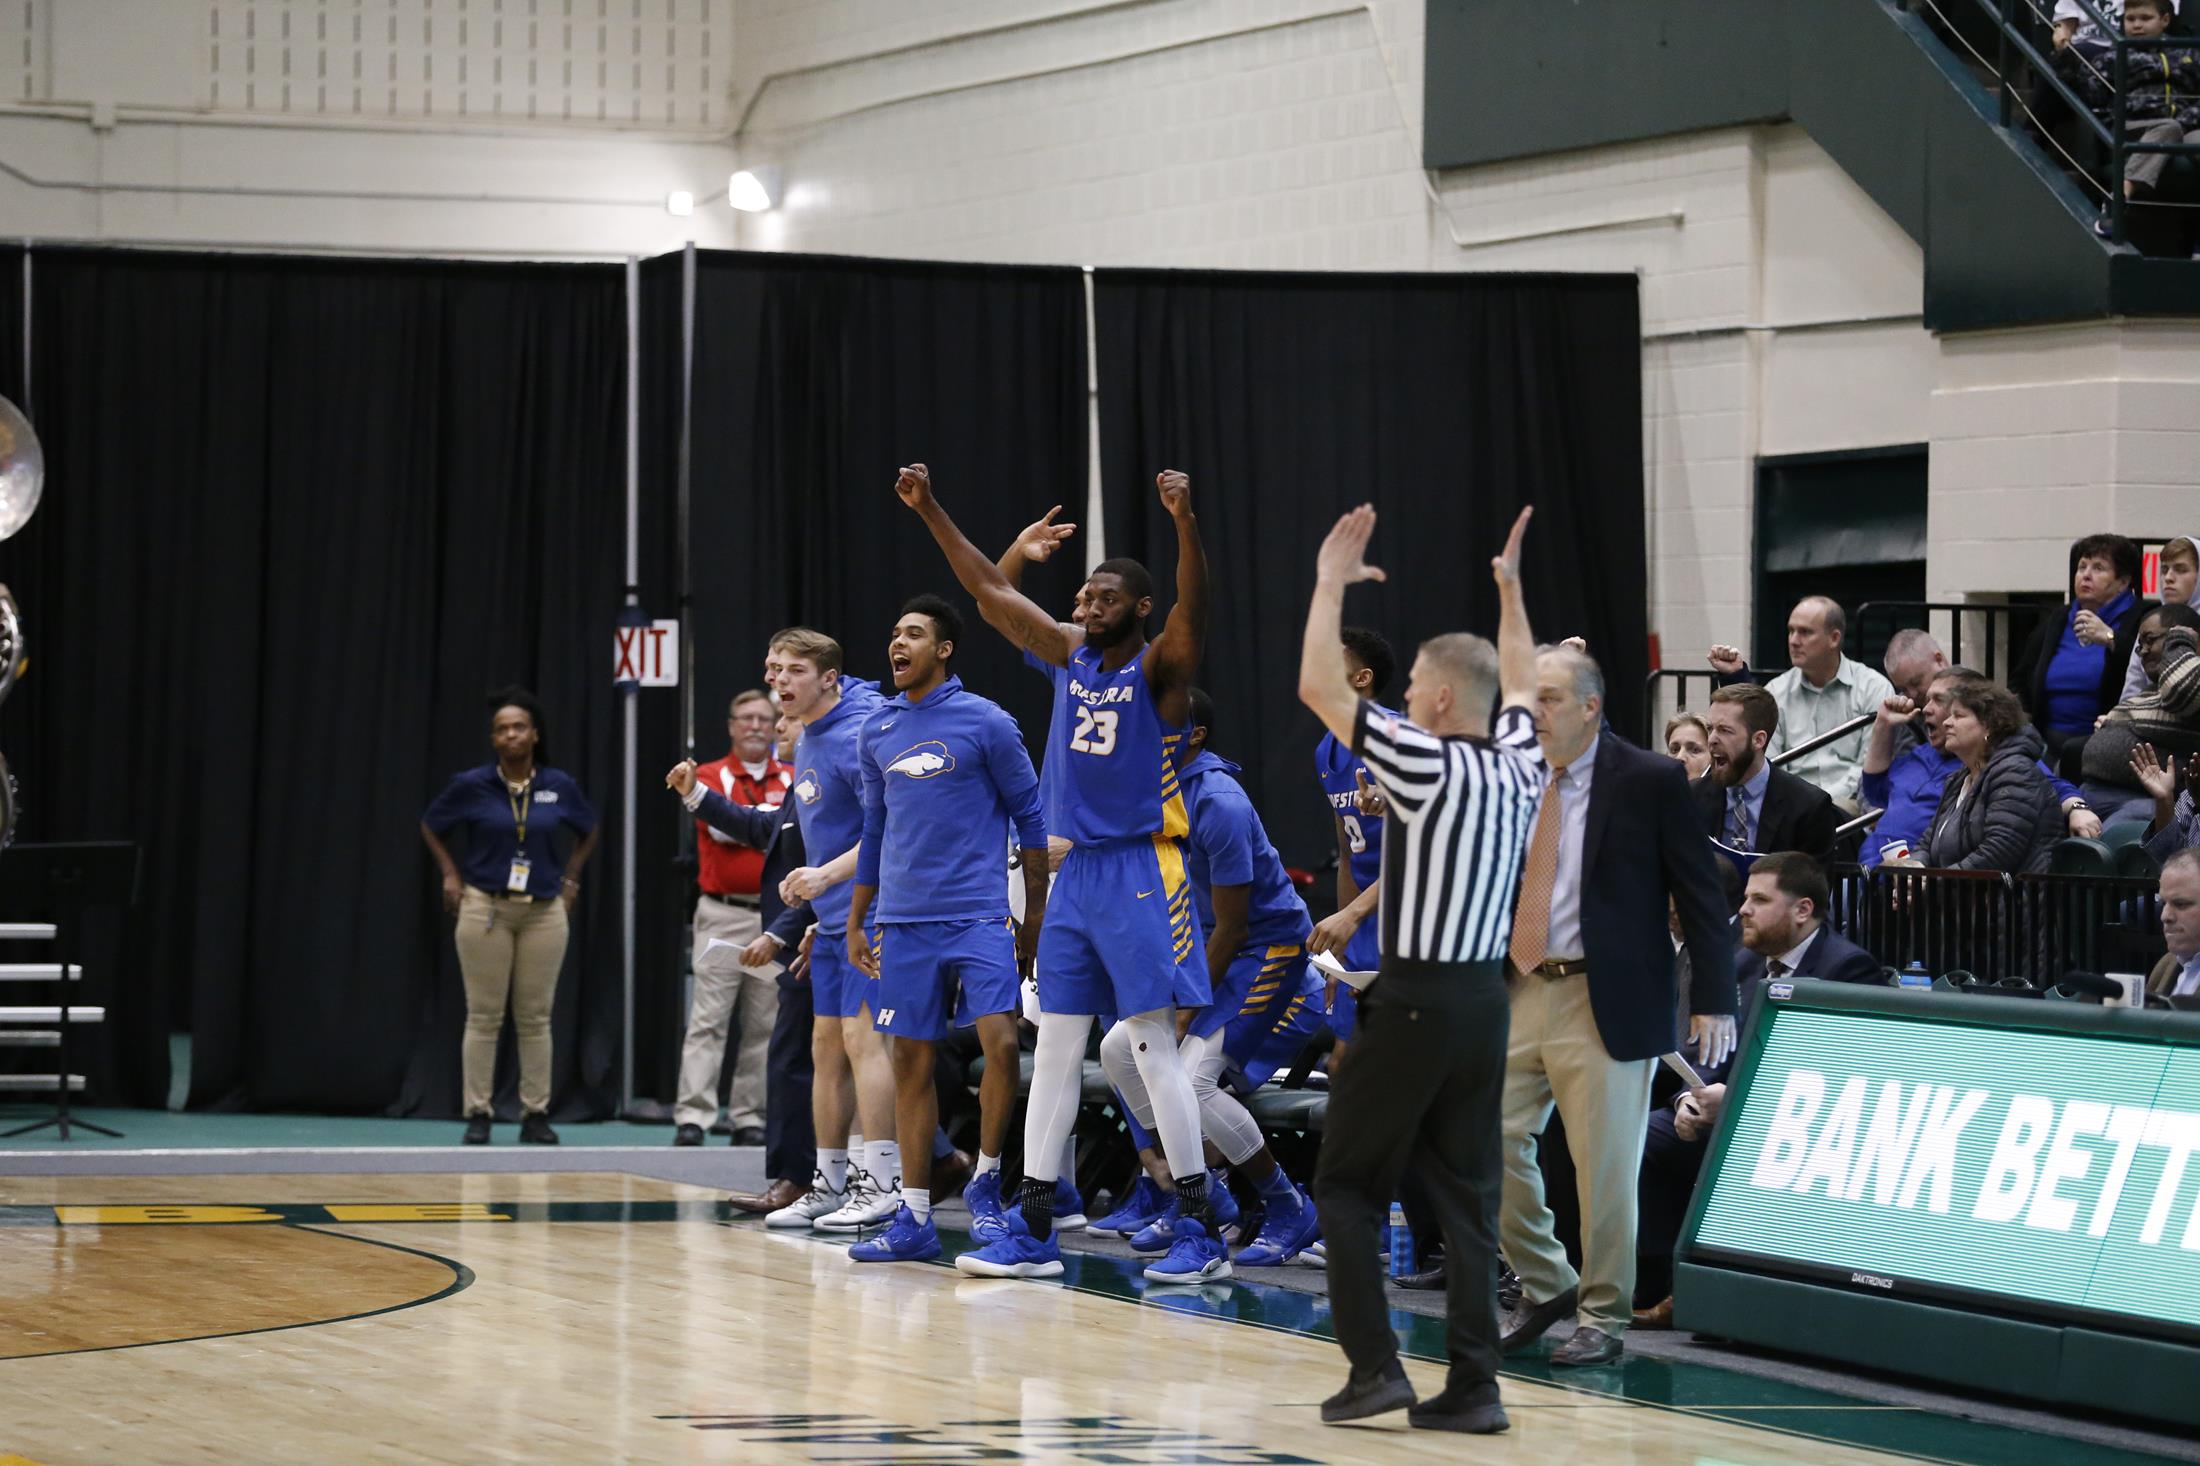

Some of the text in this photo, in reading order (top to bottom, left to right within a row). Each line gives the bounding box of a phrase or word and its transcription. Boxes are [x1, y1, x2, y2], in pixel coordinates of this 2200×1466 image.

[1070, 705, 1119, 756] 23
[876, 1008, 896, 1026] H
[1749, 1069, 1988, 1214] BANK
[1851, 1272, 1893, 1288] DAKTRONICS
